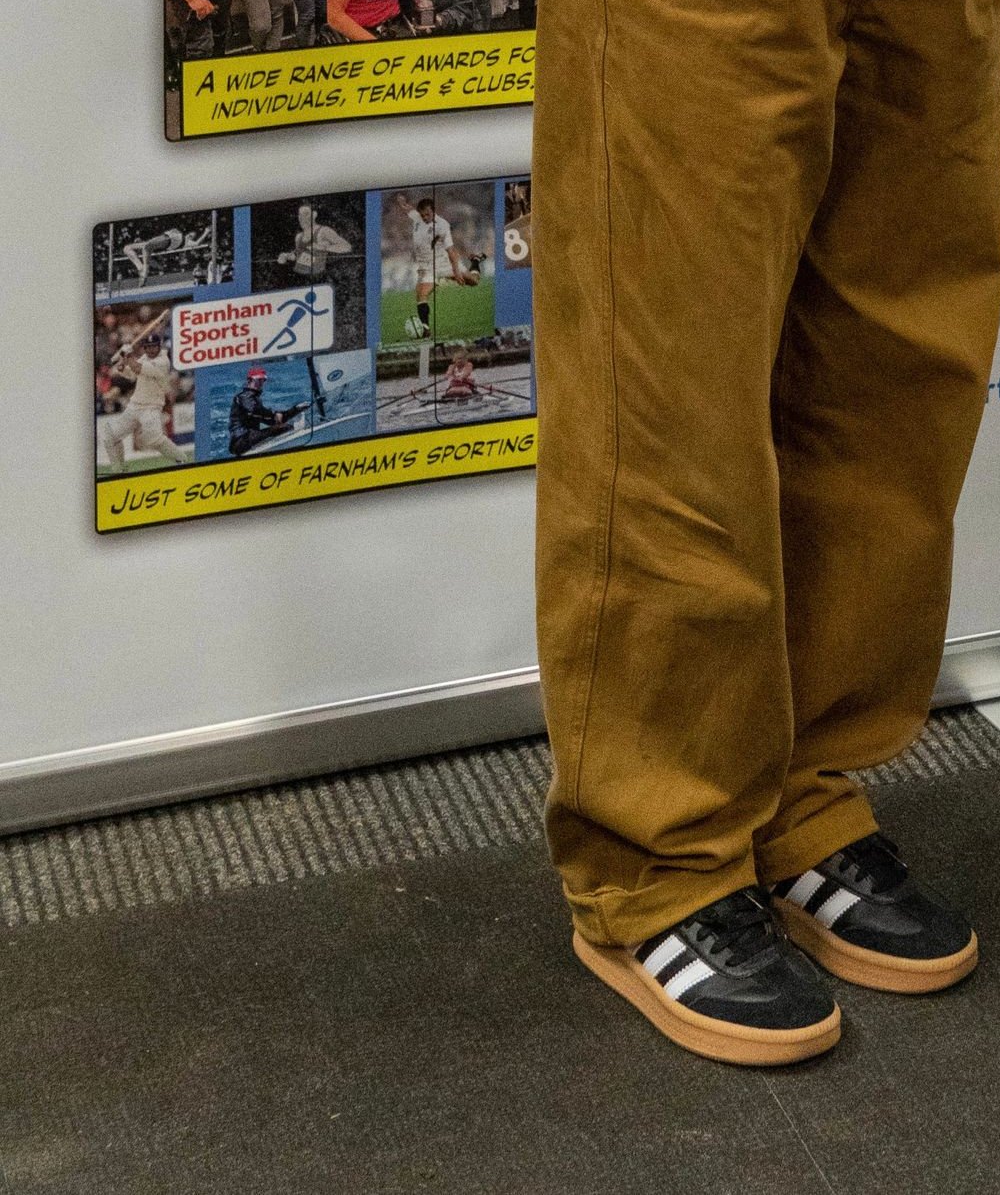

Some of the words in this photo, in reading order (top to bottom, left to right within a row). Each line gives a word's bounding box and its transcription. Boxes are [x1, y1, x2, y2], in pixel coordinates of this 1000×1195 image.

[195, 70, 215, 97] A
[226, 69, 282, 92] WIDE
[289, 60, 365, 85] RANGE
[372, 56, 405, 76] OF
[410, 48, 501, 74] AWARDS
[211, 88, 346, 121] INDIVIDUALS,
[357, 80, 431, 104] TEAMS
[439, 77, 455, 97] &
[180, 303, 273, 326] Farnham
[178, 337, 258, 364] Council
[180, 322, 250, 347] Sports
[110, 486, 177, 515] JUST
[184, 475, 252, 504] SOME
[260, 468, 290, 493] OF
[298, 450, 417, 486] FARNHAM'S
[426, 433, 535, 466] SPORTING
